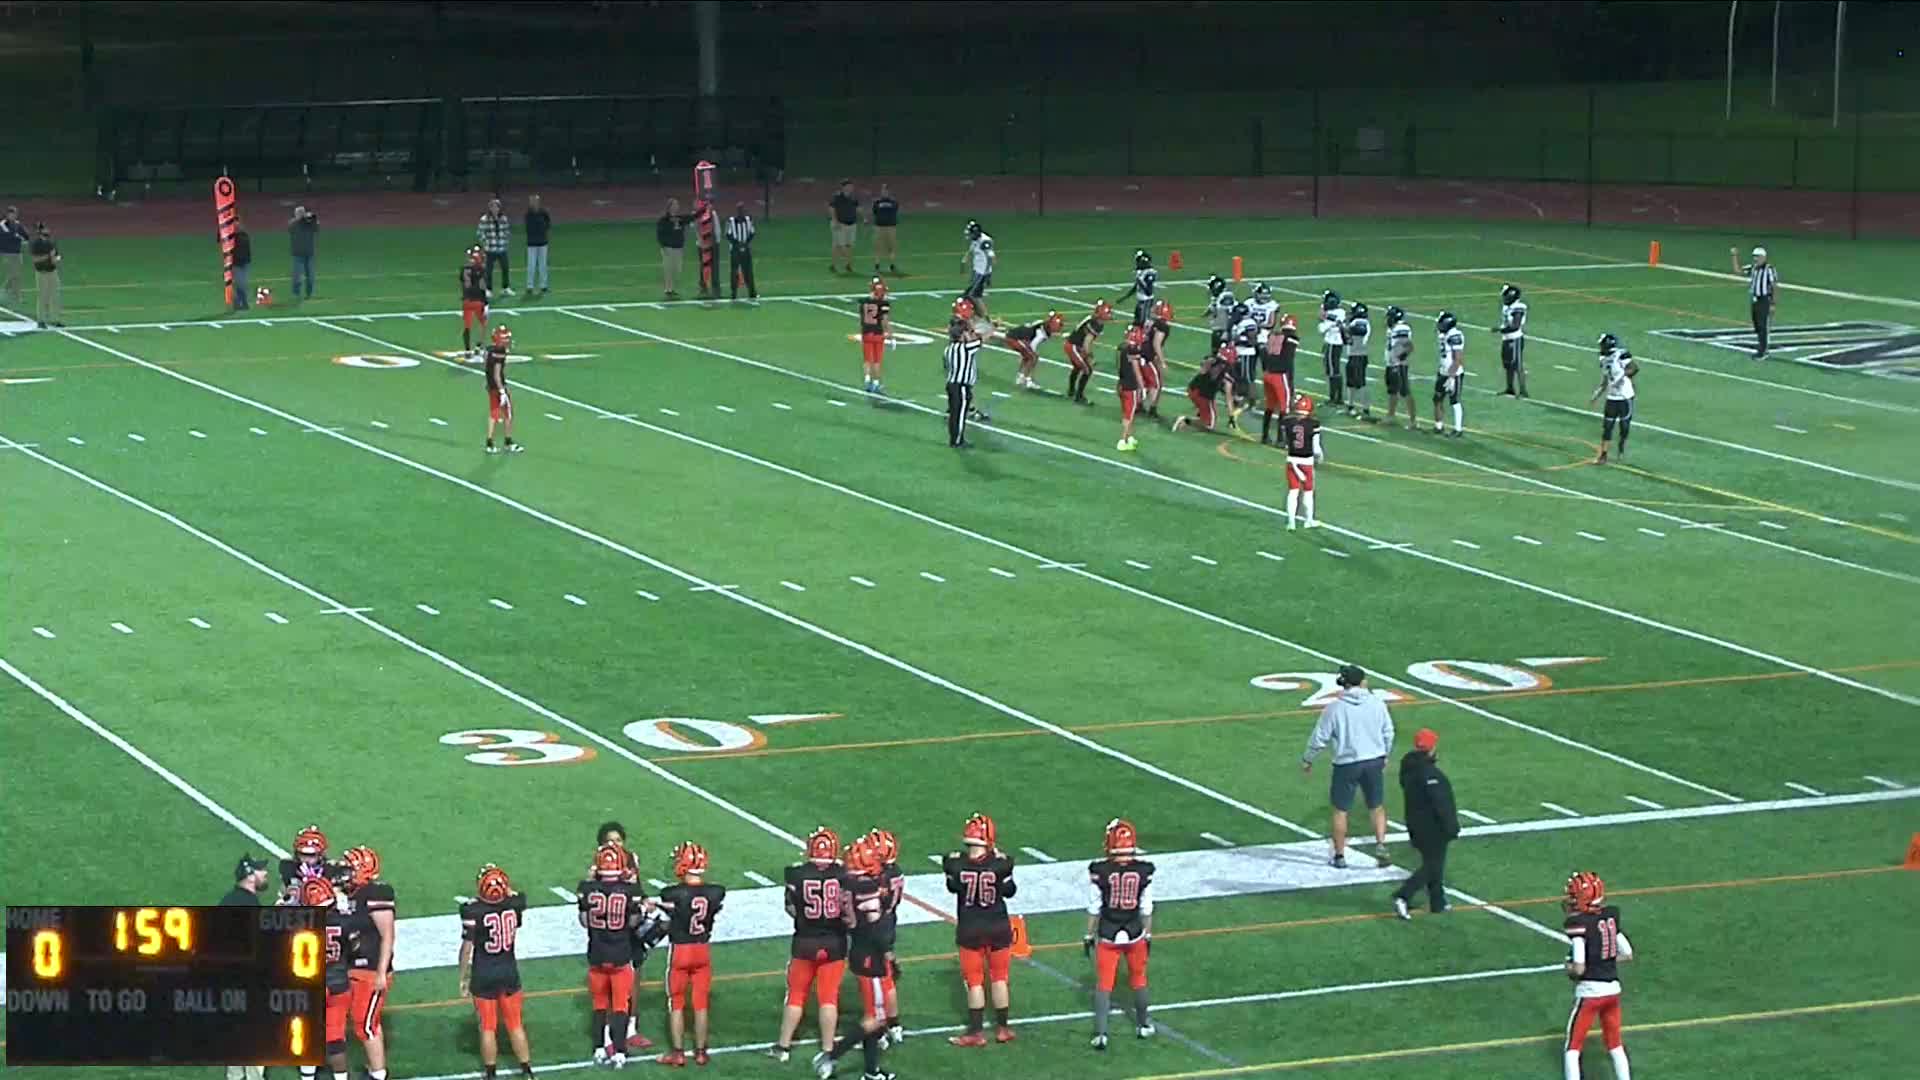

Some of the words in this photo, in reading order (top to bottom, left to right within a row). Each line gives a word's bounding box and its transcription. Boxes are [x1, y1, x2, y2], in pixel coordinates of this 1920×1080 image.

[803, 879, 841, 919] 58
[960, 871, 996, 907] 76
[1109, 872, 1140, 909] 10
[588, 893, 627, 930] 20
[690, 897, 708, 934] 2
[484, 911, 517, 953] 30
